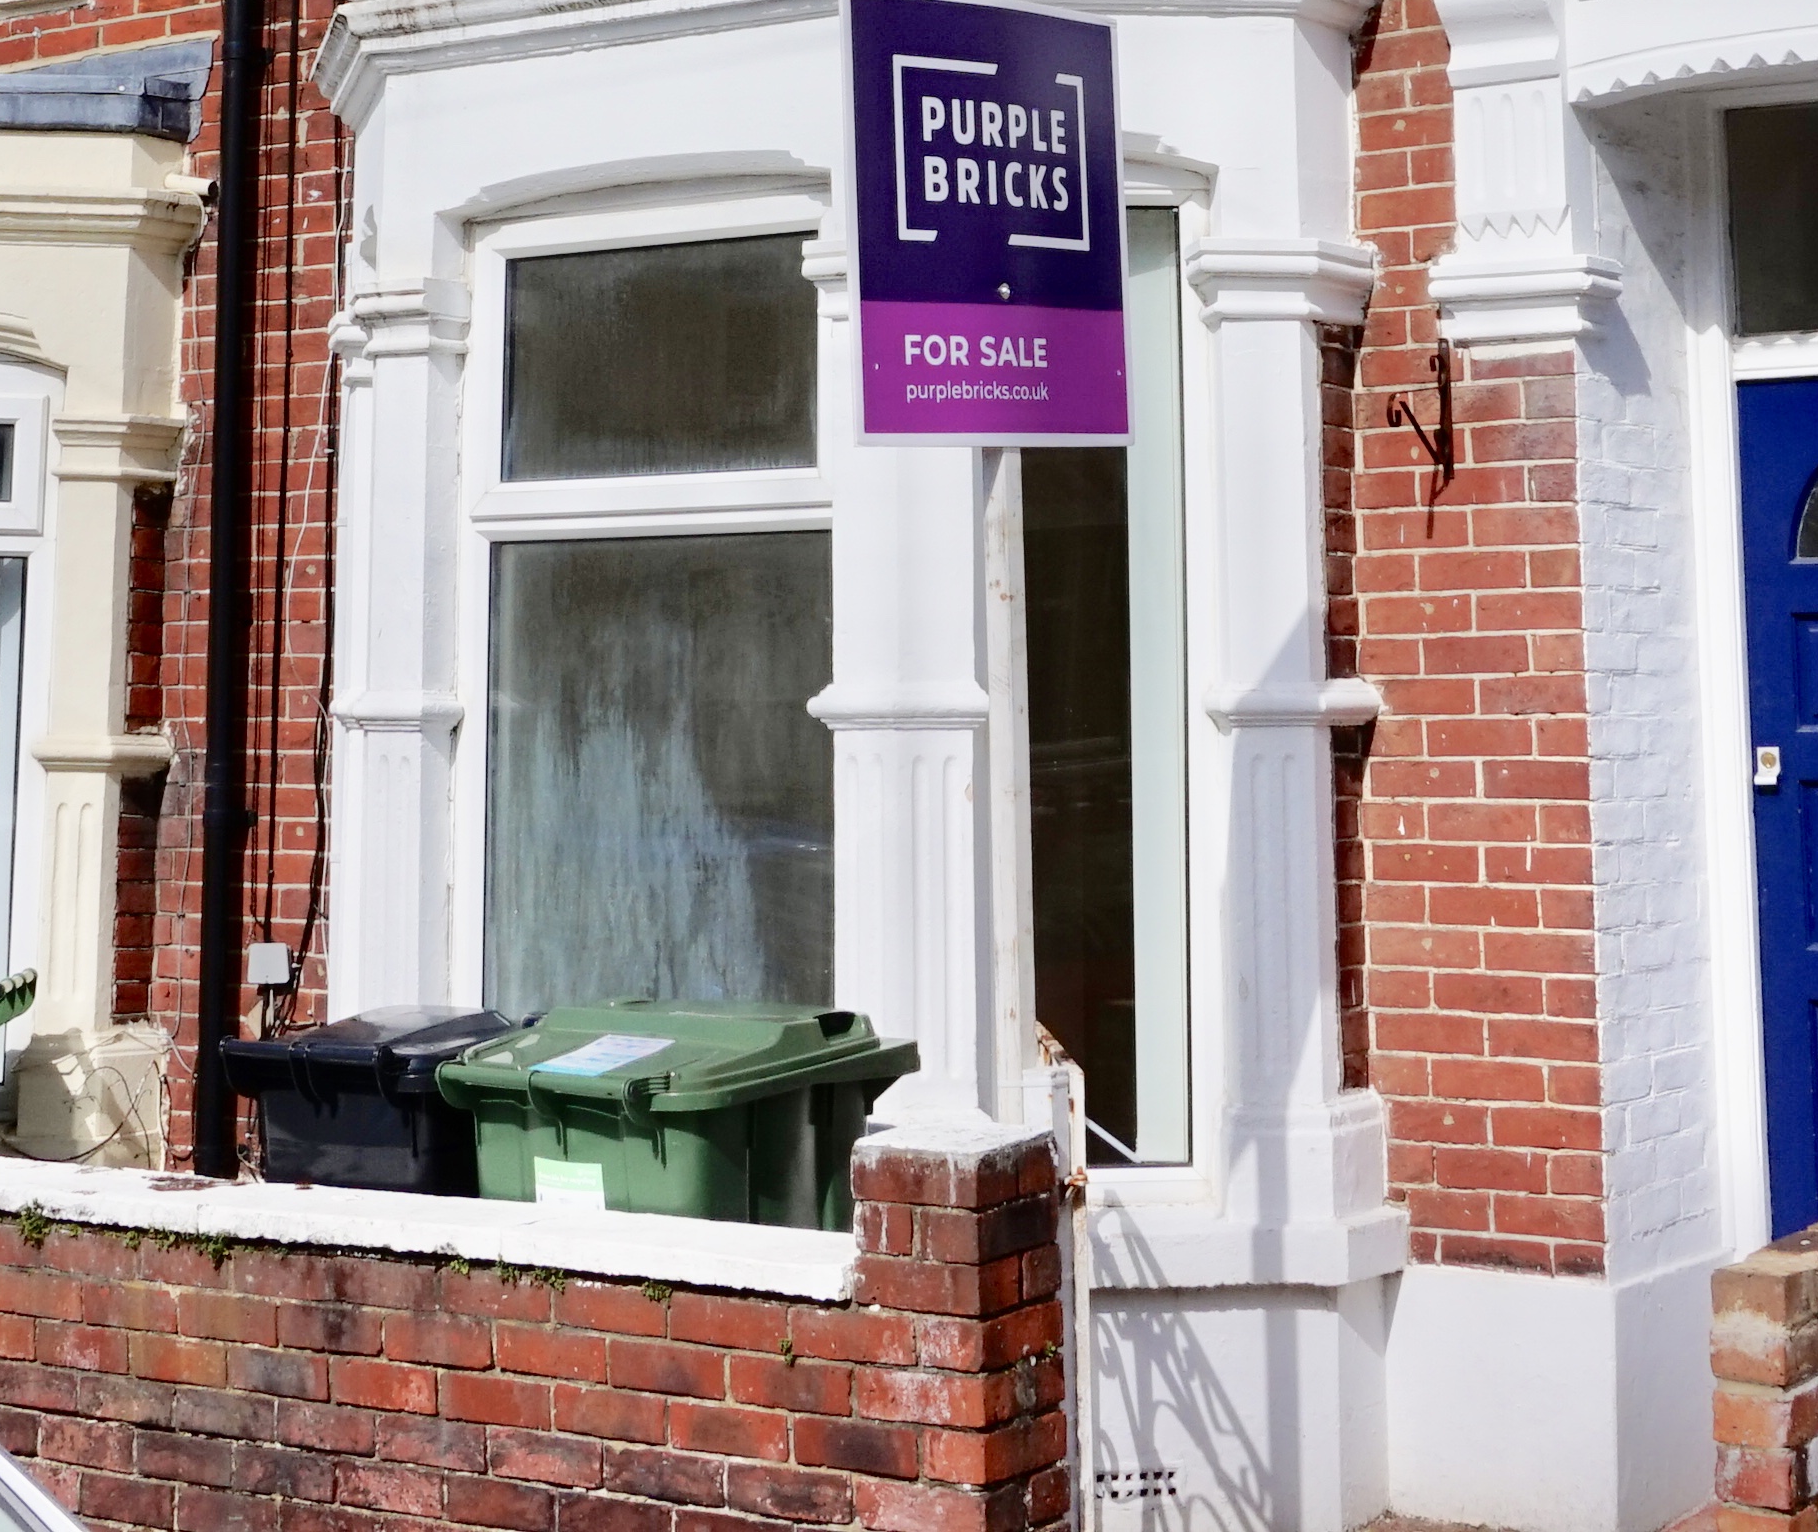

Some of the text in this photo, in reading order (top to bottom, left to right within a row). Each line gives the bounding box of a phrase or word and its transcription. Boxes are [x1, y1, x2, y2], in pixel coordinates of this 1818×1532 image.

[921, 95, 1067, 155] PURPLE
[923, 155, 1069, 212] BRICKS
[904, 334, 1049, 368] FOR SALE
[906, 379, 1050, 404] purplebricks.co.uk
